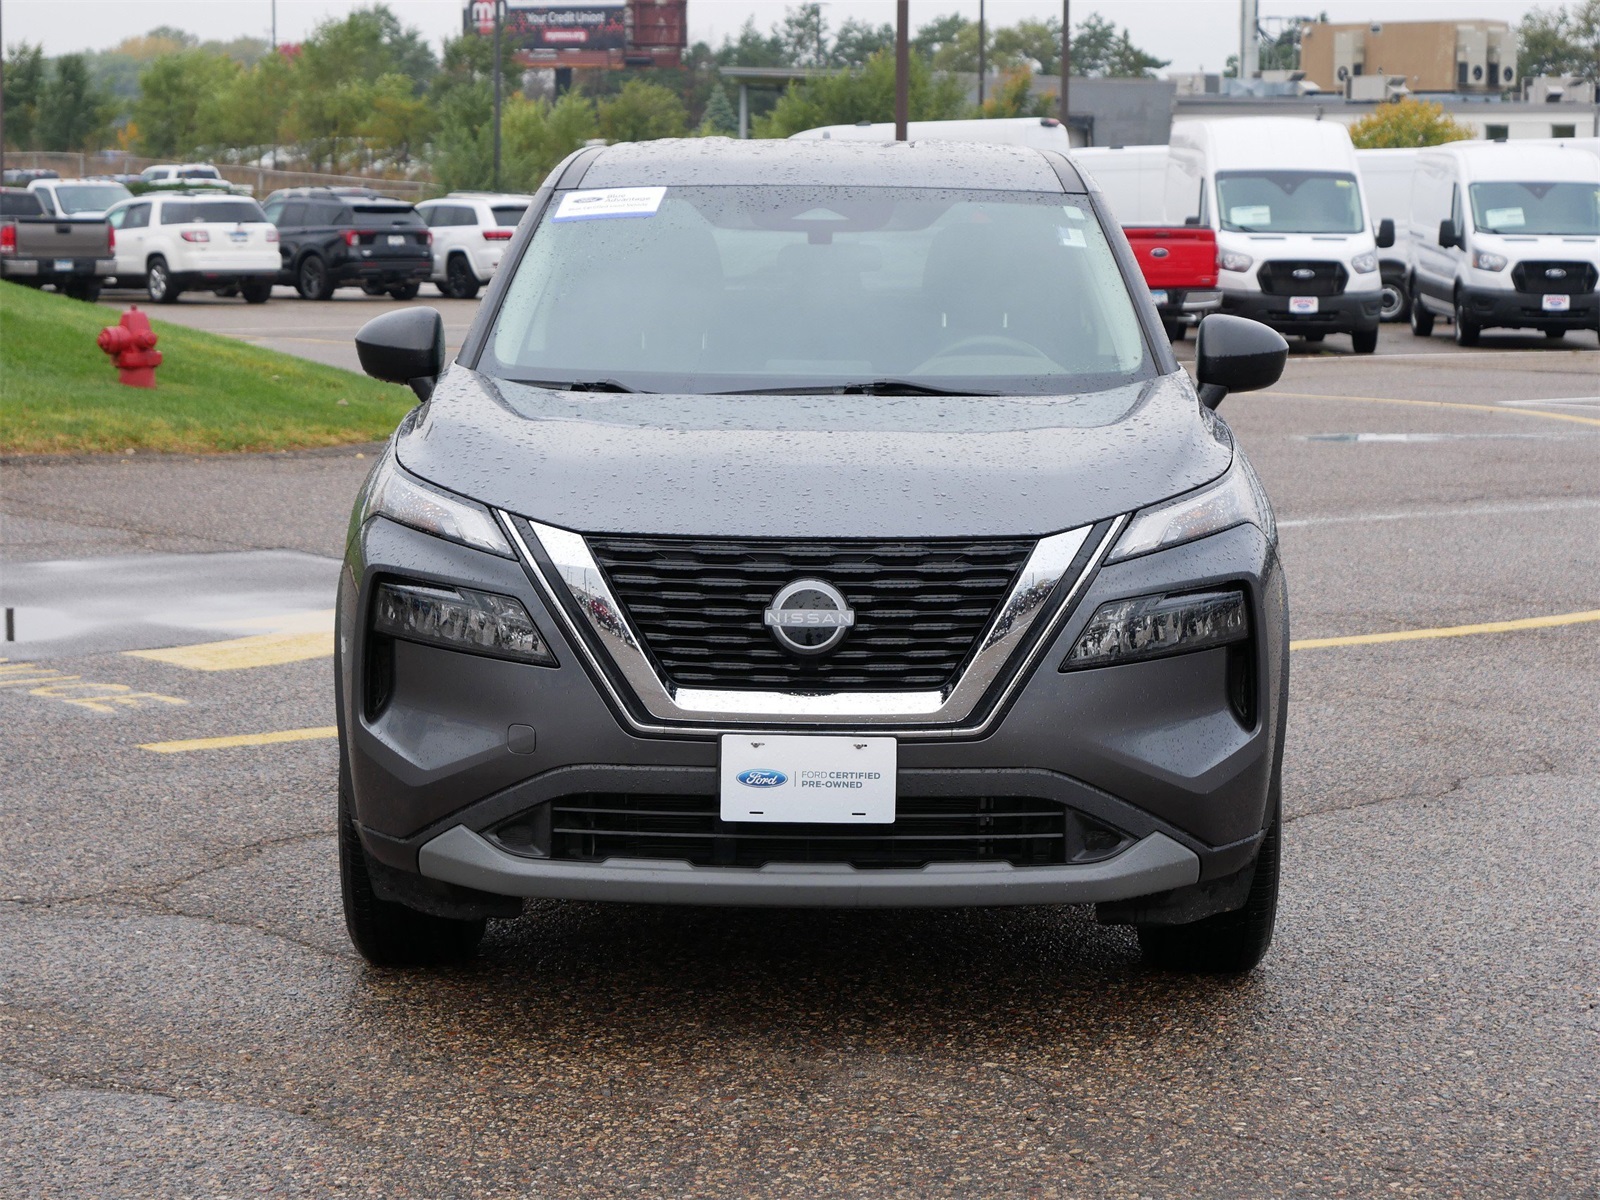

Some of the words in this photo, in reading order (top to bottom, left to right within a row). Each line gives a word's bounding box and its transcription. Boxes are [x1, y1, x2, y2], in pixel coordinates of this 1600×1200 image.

[526, 11, 547, 24] Your
[549, 10, 575, 24] Credit
[767, 612, 852, 624] NISSAN
[746, 772, 777, 785] Ford
[801, 771, 828, 779] FORD
[829, 771, 881, 780] CERTIFIED
[801, 781, 863, 789] PRE-OWNED
